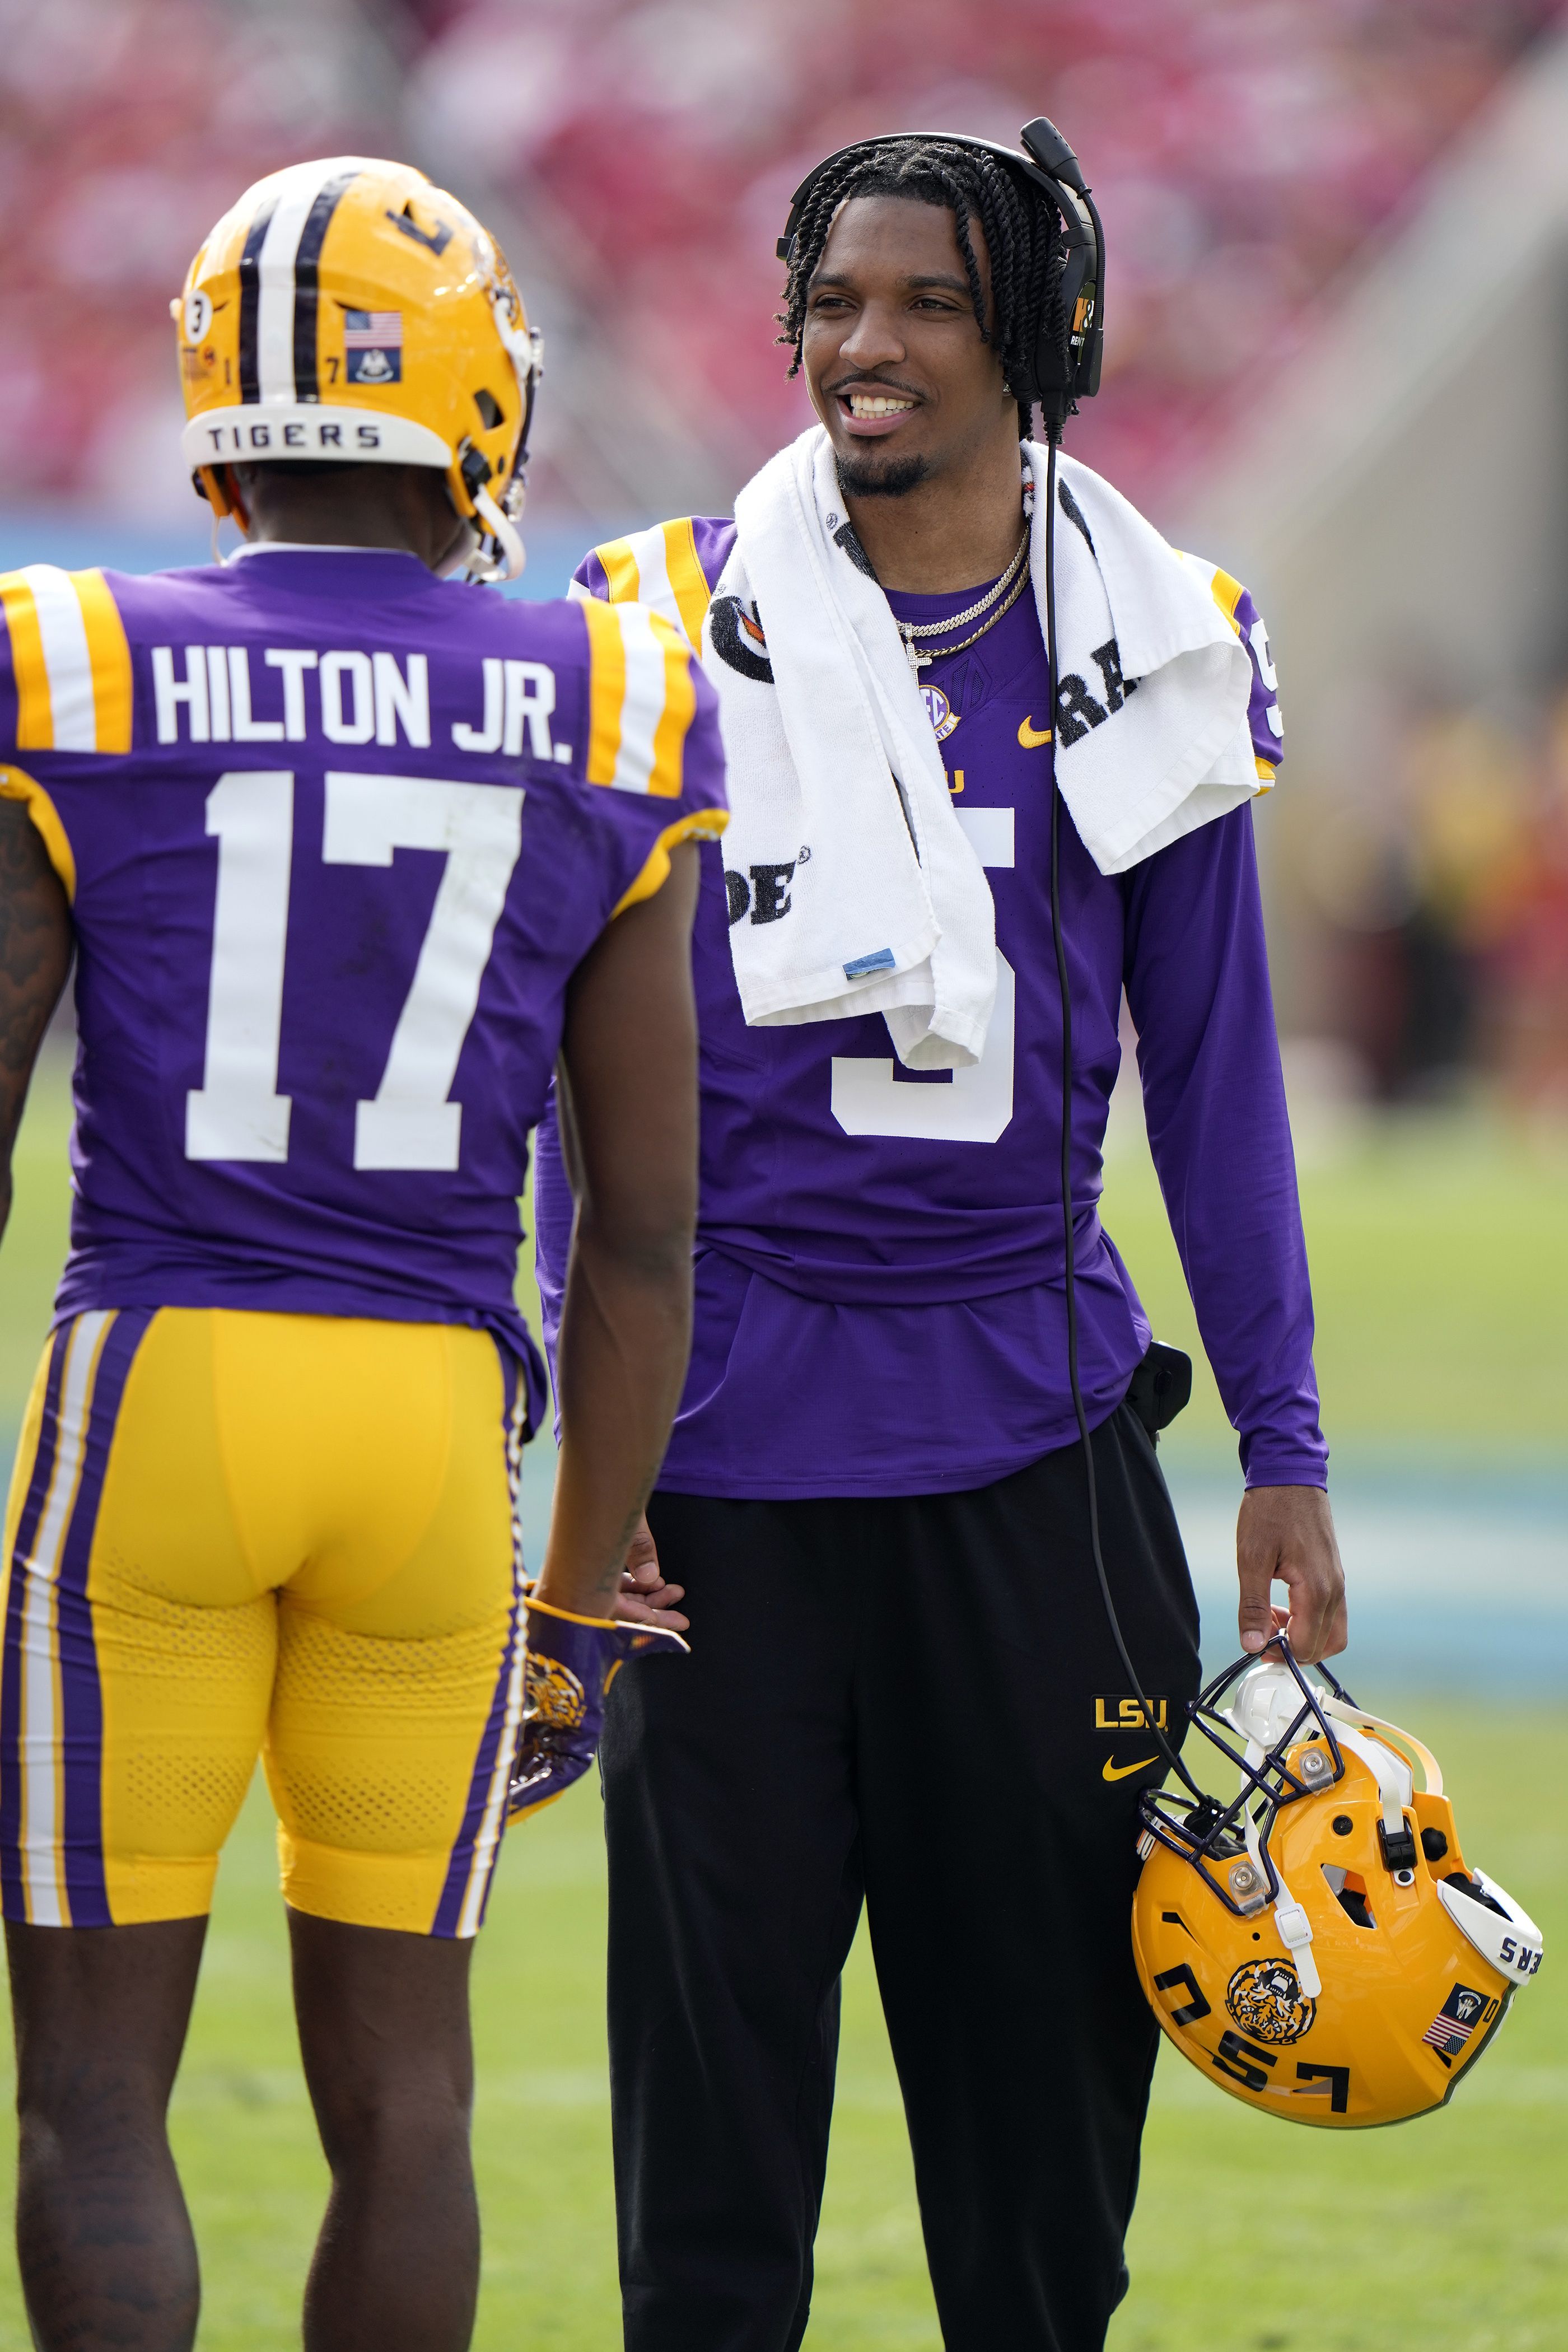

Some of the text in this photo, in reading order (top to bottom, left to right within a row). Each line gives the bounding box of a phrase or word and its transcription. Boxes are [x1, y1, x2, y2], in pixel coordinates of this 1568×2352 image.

[209, 424, 380, 450] TIGERS
[151, 646, 572, 764] HILTON JR.
[185, 771, 526, 1170] 17
[1095, 1698, 1167, 1729] LSU
